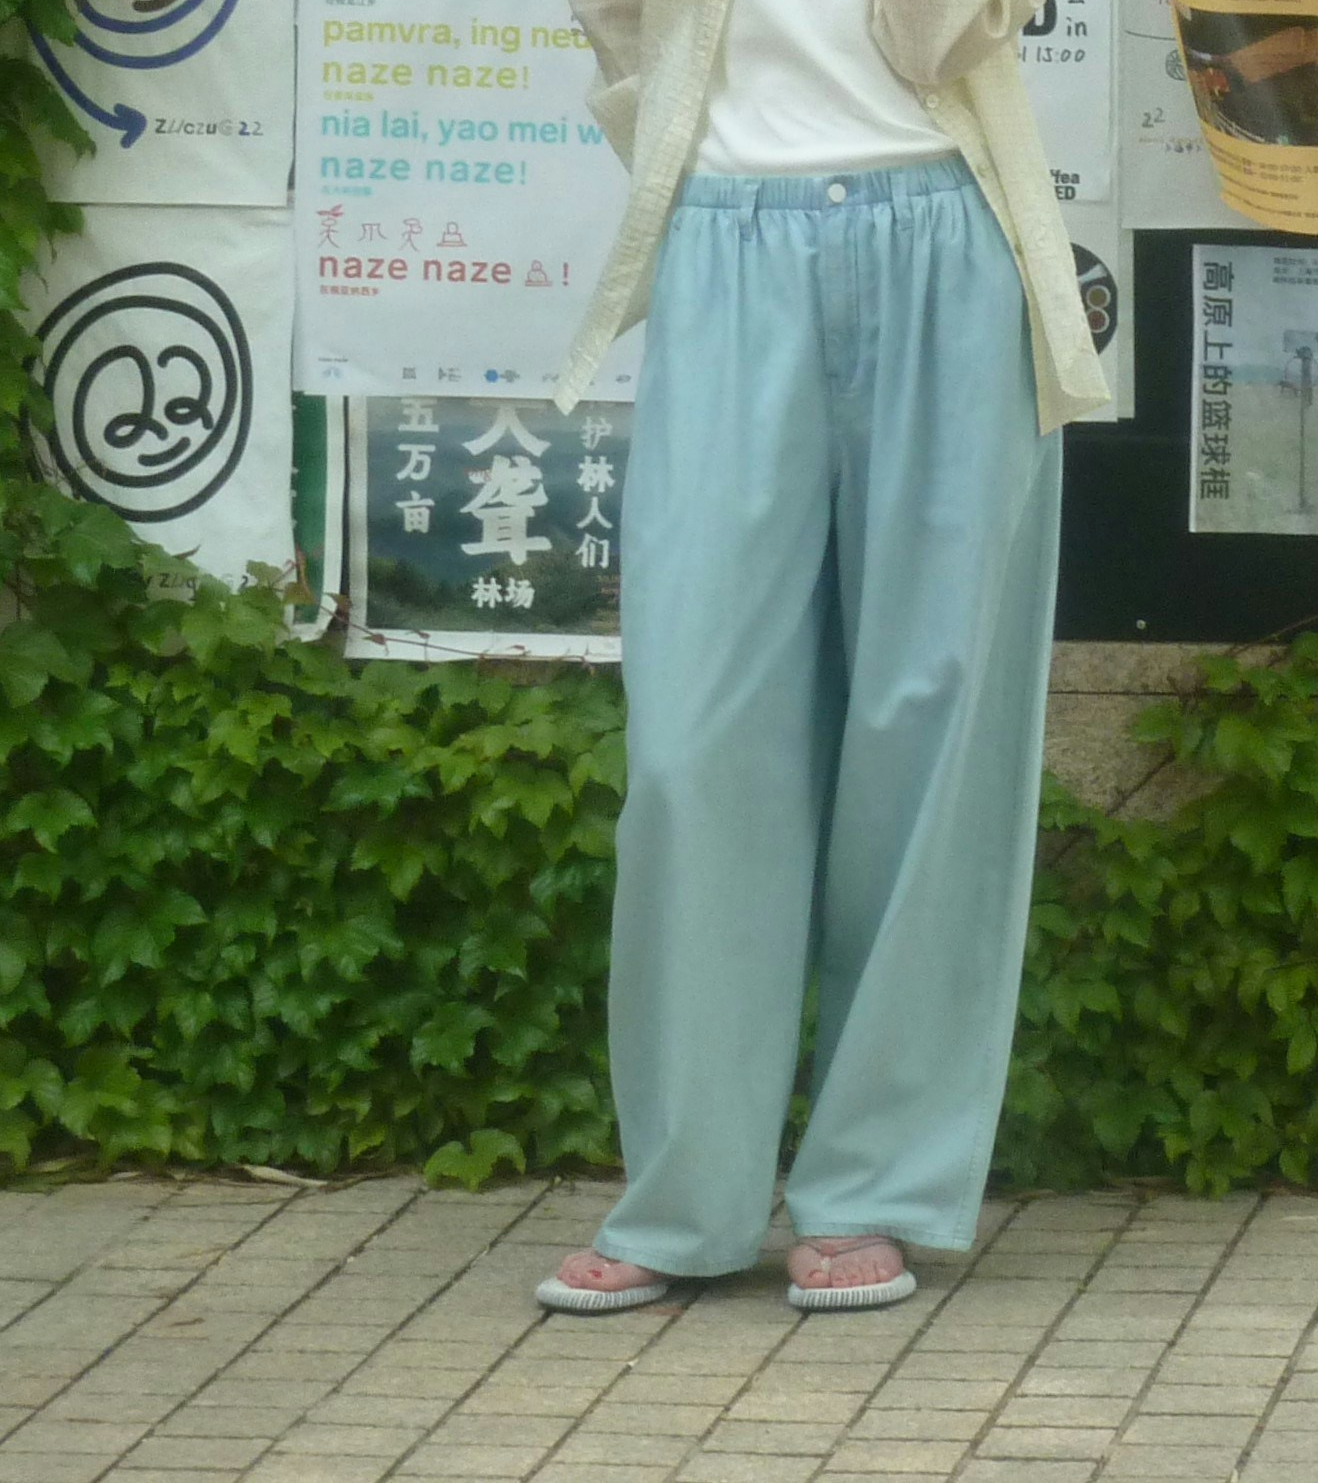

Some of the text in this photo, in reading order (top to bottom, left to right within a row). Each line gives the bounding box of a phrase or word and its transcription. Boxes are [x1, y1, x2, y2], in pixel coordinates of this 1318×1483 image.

[323, 20, 460, 49] pamvra,
[471, 18, 522, 54] ing
[322, 61, 530, 90] naze naze!
[321, 109, 371, 137] nia
[438, 118, 498, 147] yao
[508, 117, 568, 144] mei
[320, 156, 527, 185] naze naze!
[319, 255, 409, 280] naze
[423, 258, 512, 283] naze
[395, 397, 439, 534] 五万亩
[471, 577, 535, 609] 林场
